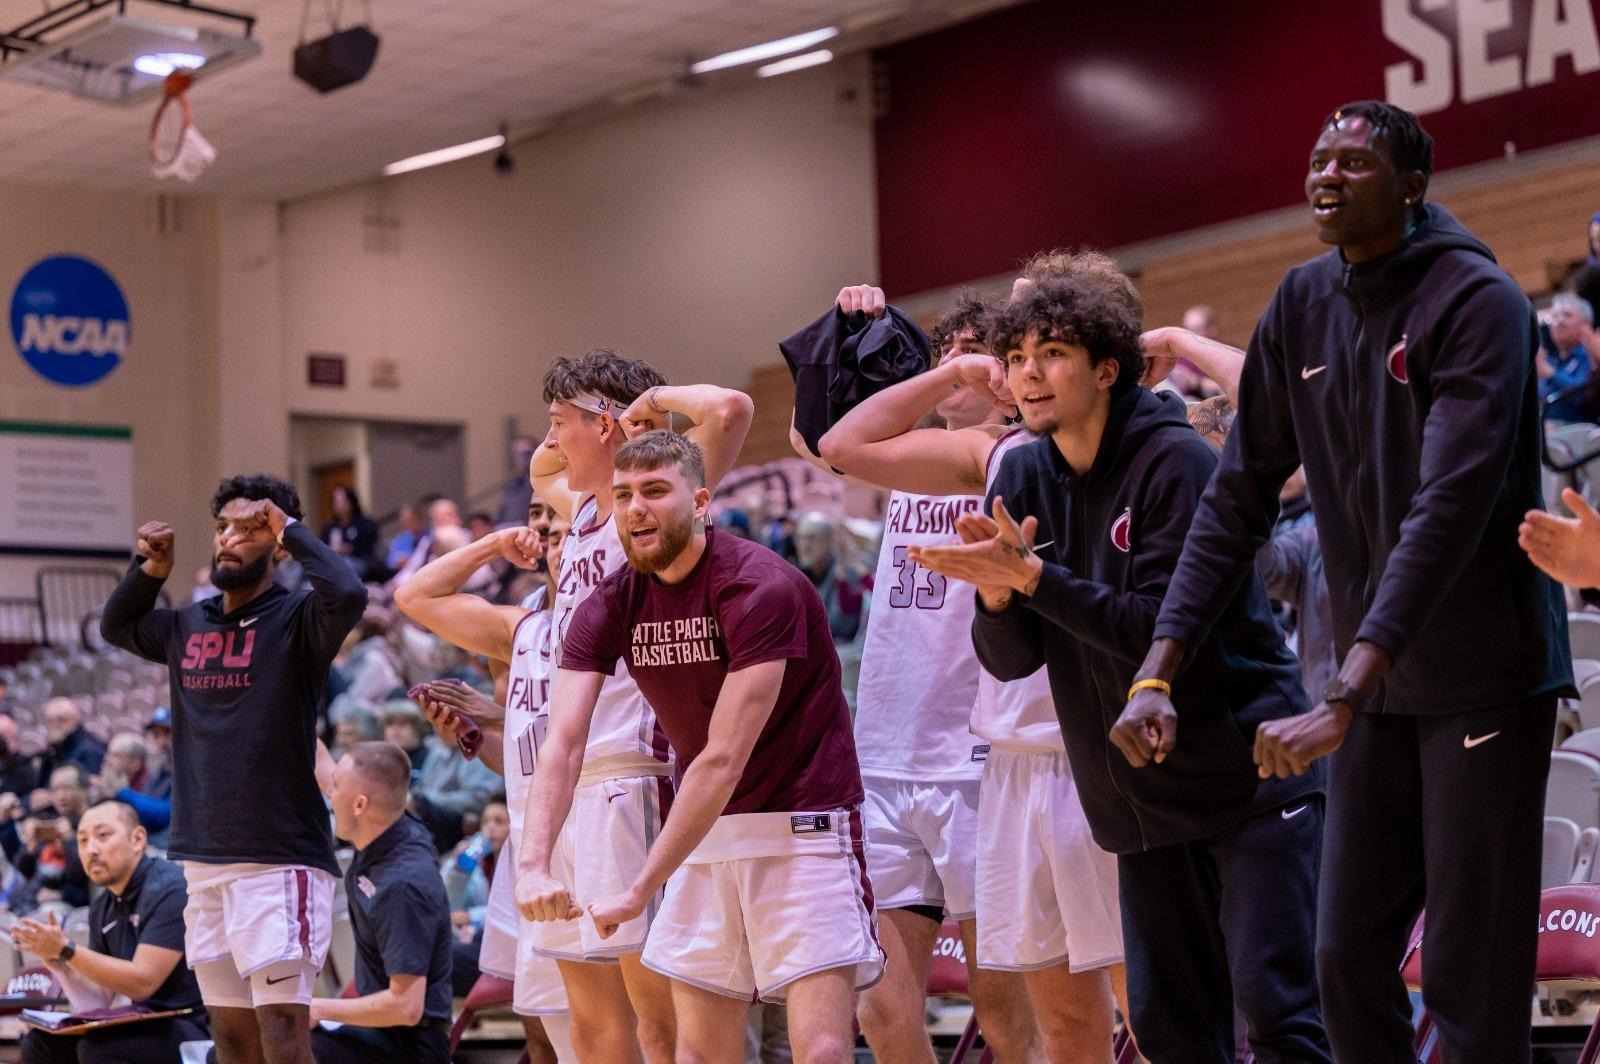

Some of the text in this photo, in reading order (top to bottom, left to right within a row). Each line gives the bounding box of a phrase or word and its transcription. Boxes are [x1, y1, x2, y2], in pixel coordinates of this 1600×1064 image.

[1381, 0, 1600, 117] SEA
[21, 312, 128, 358] NCAA
[181, 629, 256, 670] SPU
[631, 621, 672, 644] ATTLE
[632, 639, 720, 667] BASKETBALL
[182, 673, 252, 690] BASKETBALL
